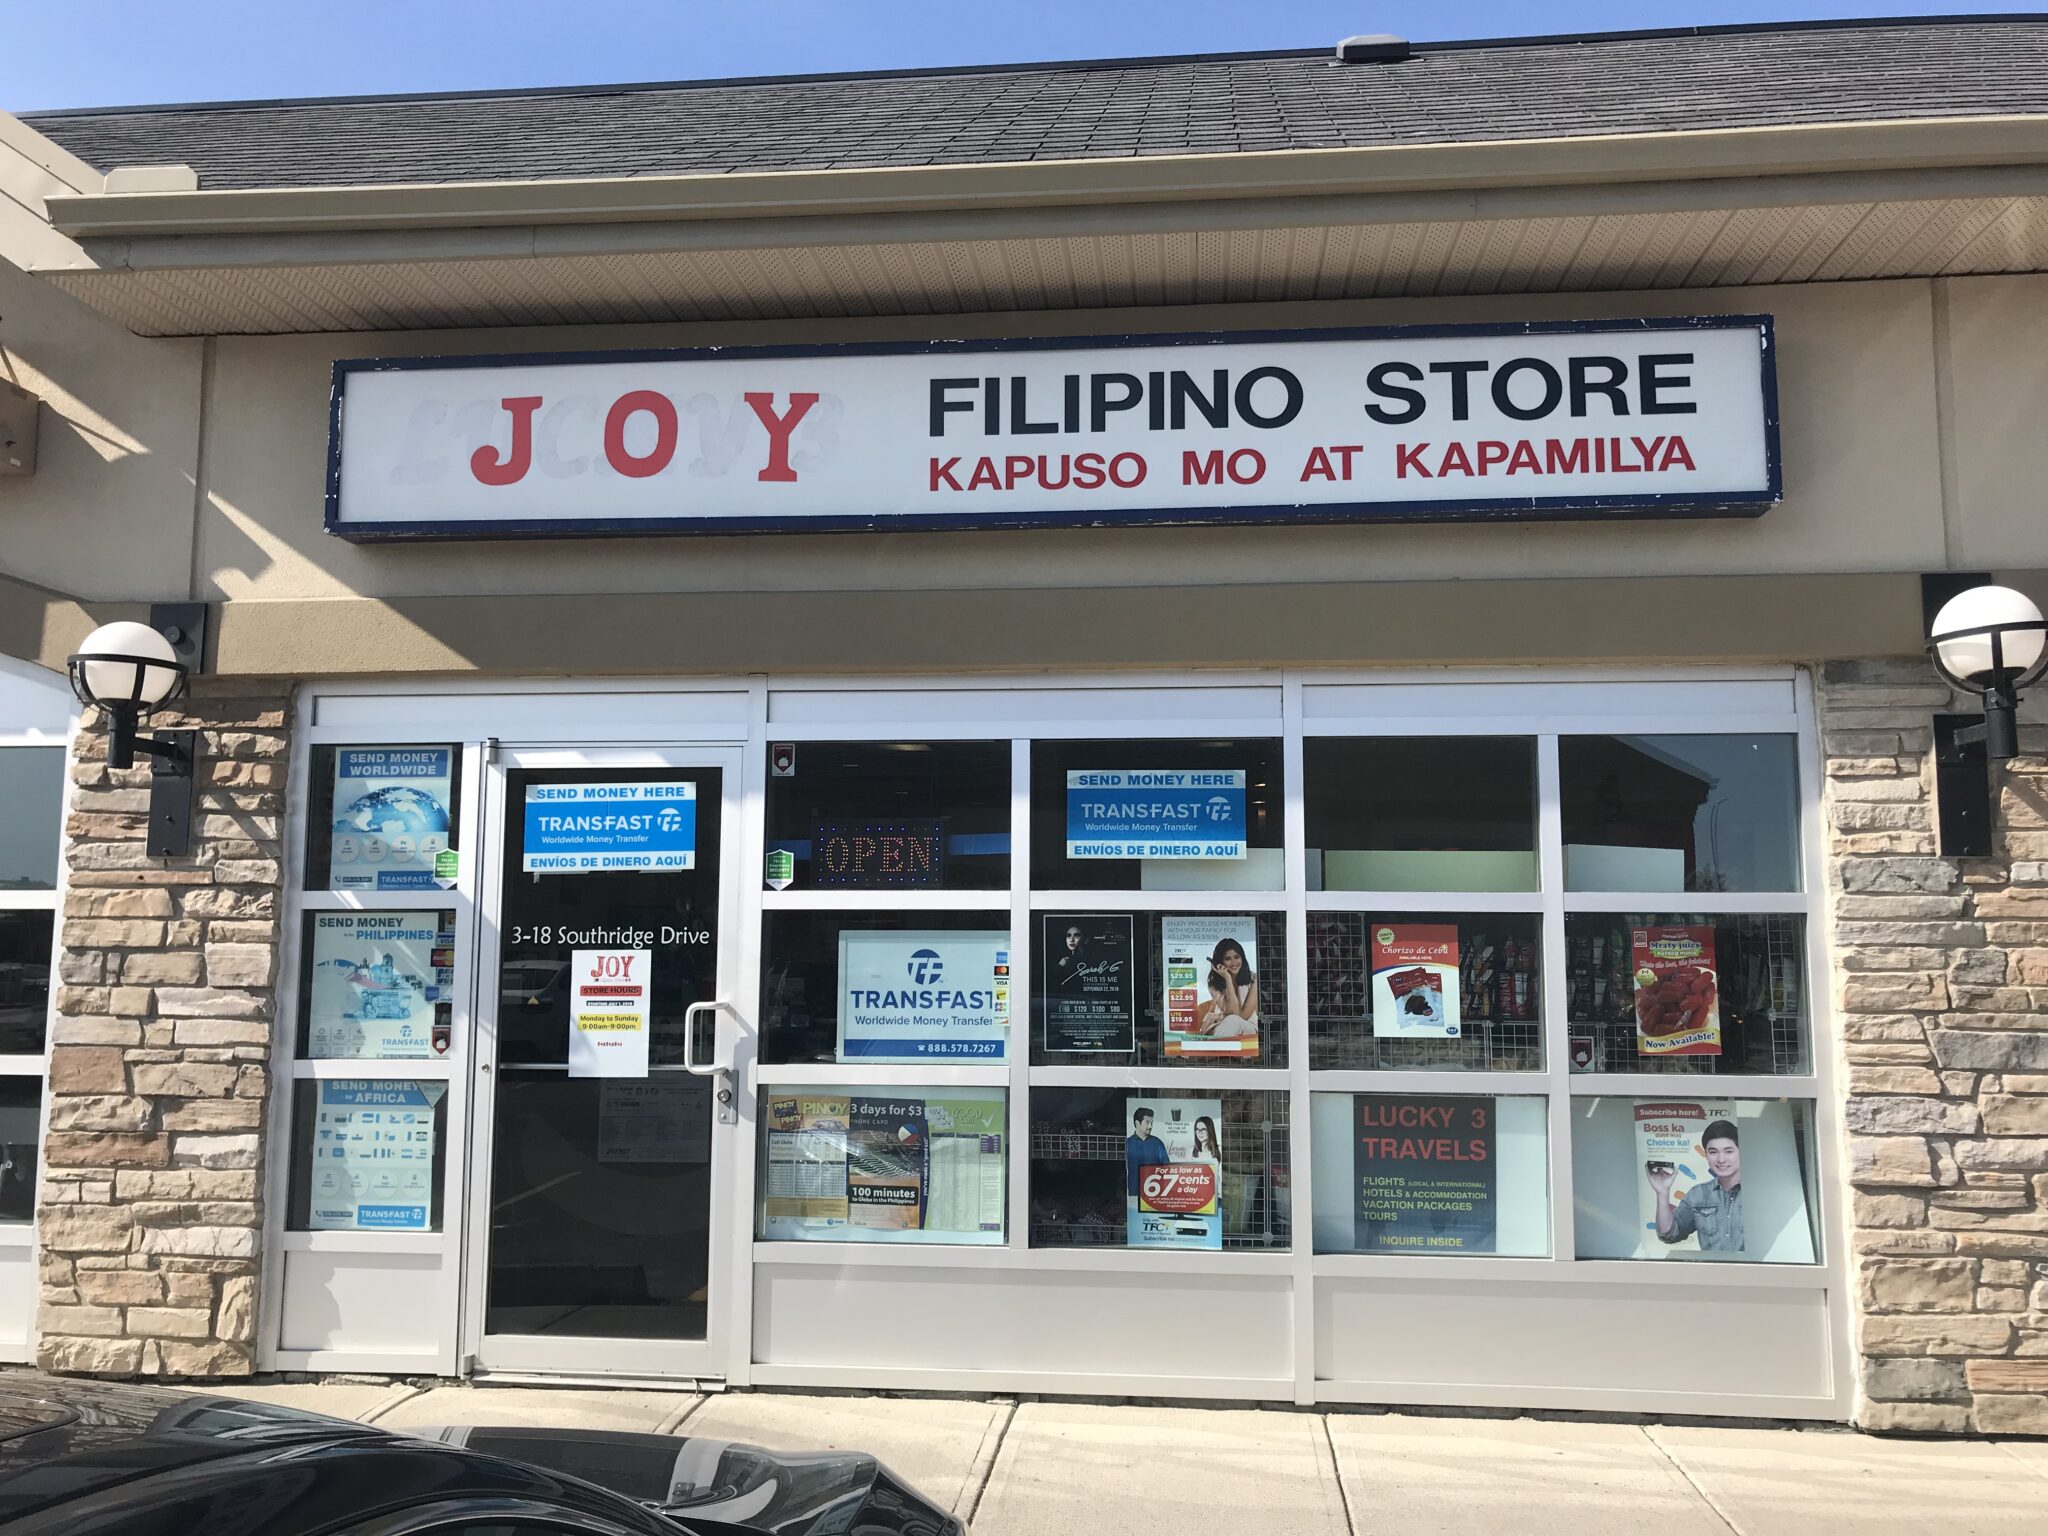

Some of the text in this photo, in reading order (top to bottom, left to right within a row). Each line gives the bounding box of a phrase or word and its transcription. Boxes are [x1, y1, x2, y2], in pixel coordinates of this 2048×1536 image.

[928, 353, 1697, 437] FILIPINO STORE
[470, 389, 820, 487] JOY
[928, 435, 1697, 492] KAPUSO MO AT KAPAMILYA
[350, 753, 438, 764] SEND MONEY
[350, 765, 436, 776] WORLDWIDE
[1078, 775, 1234, 785] SEND MONEY HERE
[537, 787, 685, 799] SEND MONEY HERE
[1081, 803, 1201, 819] TRANSFAST
[538, 815, 653, 831] TRANSFAST
[1085, 823, 1197, 833] Worldwide Money Transfer
[541, 834, 649, 845] Worldwide Money Transfer
[826, 837, 933, 872] OPEN
[1074, 843, 1238, 857] ENVÍOS DE DINERO AQUÍ
[530, 854, 687, 868] ENVÍOS DE DINERO AQUÍ
[381, 876, 428, 884] TRANSFAST
[319, 918, 404, 928] SEND MONEY
[356, 930, 434, 940] PHILIPPINES
[512, 926, 710, 949] 3-18 Southridge Drive
[1382, 946, 1414, 954] Chorizo
[1416, 946, 1427, 954] de
[1650, 941, 1701, 950] Meaty juicy
[591, 955, 635, 978] JOY
[611, 986, 638, 994] HOURS
[851, 990, 993, 1010] TRANSFAST
[1092, 1005, 1105, 1013] $100
[855, 1015, 993, 1028] Worldwide Money Transfer
[382, 1038, 430, 1046] TRANSFAST
[1645, 1032, 1716, 1049] Now Available!
[927, 1044, 996, 1053] 888.578.7267
[332, 1081, 368, 1091] SEND
[355, 1093, 406, 1103] AFRICA
[774, 1101, 795, 1109] PINOY
[802, 1102, 849, 1115] PINOY
[851, 1104, 922, 1117] 3 days for $3
[1639, 1108, 1699, 1116] Subscribe here!
[1708, 1109, 1728, 1117] TFC
[1363, 1105, 1487, 1129] LUCKY 3
[1643, 1123, 1685, 1133] Boss ka
[1646, 1138, 1690, 1147] Choice ka!
[1363, 1137, 1487, 1161] TRAVELS
[1143, 1174, 1179, 1197] 67
[1363, 1177, 1405, 1186] FLIGHTS
[852, 1187, 915, 1199] 100 minutes
[1183, 1186, 1198, 1194] day
[1363, 1189, 1403, 1198] HOTELS
[1412, 1191, 1487, 1199] ACCOMMODATION
[1363, 1200, 1472, 1211] VACATION PACKAGES
[361, 1210, 410, 1219] TRANSFAST
[1363, 1211, 1398, 1220] TOURS
[1143, 1223, 1165, 1231] TFC
[1380, 1236, 1463, 1246] INQUIRE INSIDE
